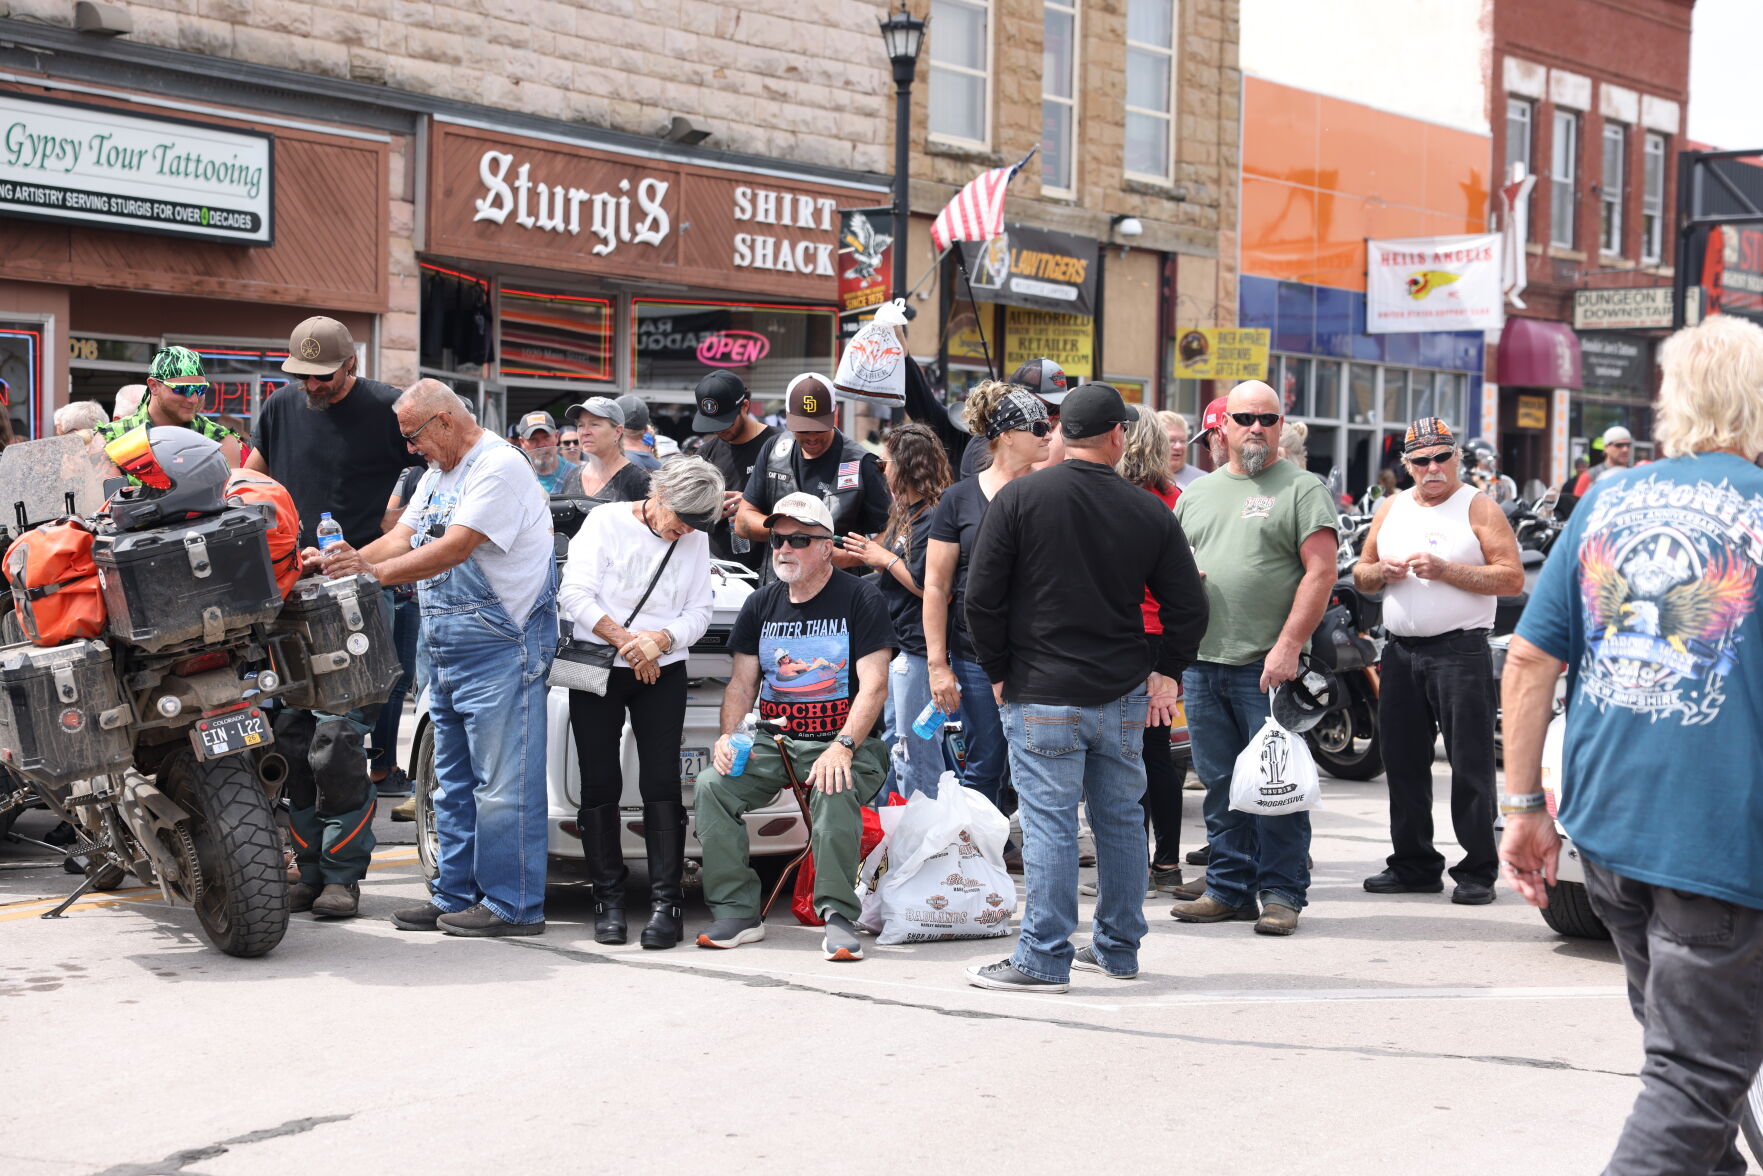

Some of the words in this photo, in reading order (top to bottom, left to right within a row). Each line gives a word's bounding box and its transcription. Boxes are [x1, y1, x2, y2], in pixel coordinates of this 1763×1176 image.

[5, 122, 82, 172] Gypsy
[89, 133, 148, 171] Tour
[152, 142, 262, 199] Tattooing
[14, 185, 64, 205] ARTISTRY
[65, 192, 109, 212] SERVING
[110, 198, 152, 216] STURGIS
[153, 202, 173, 219] FOR
[175, 205, 200, 222] OVER
[209, 210, 252, 229] DECADES
[734, 186, 836, 231] SHIRT
[734, 233, 835, 277] SHACK
[1381, 251, 1426, 267] HELLS
[1432, 247, 1494, 264] ANGELS
[846, 296, 867, 310] SINCE
[1577, 289, 1657, 307] DUNGEON
[1008, 311, 1090, 326] AUTHORIZED
[702, 335, 762, 362] OPEN
[1018, 337, 1079, 352] RETAILER
[761, 620, 803, 639] HOTTER
[806, 618, 838, 637] THAN
[840, 617, 849, 636] A
[761, 699, 849, 718] HOOCHIE
[213, 714, 245, 726] COLORADO
[202, 727, 228, 746] EIN
[247, 734, 257, 743] 26
[817, 730, 840, 738] Jack
[1255, 794, 1305, 808] PROGRESSIVE
[905, 907, 968, 924] BADLANDS
[907, 932, 926, 940] SHOP
